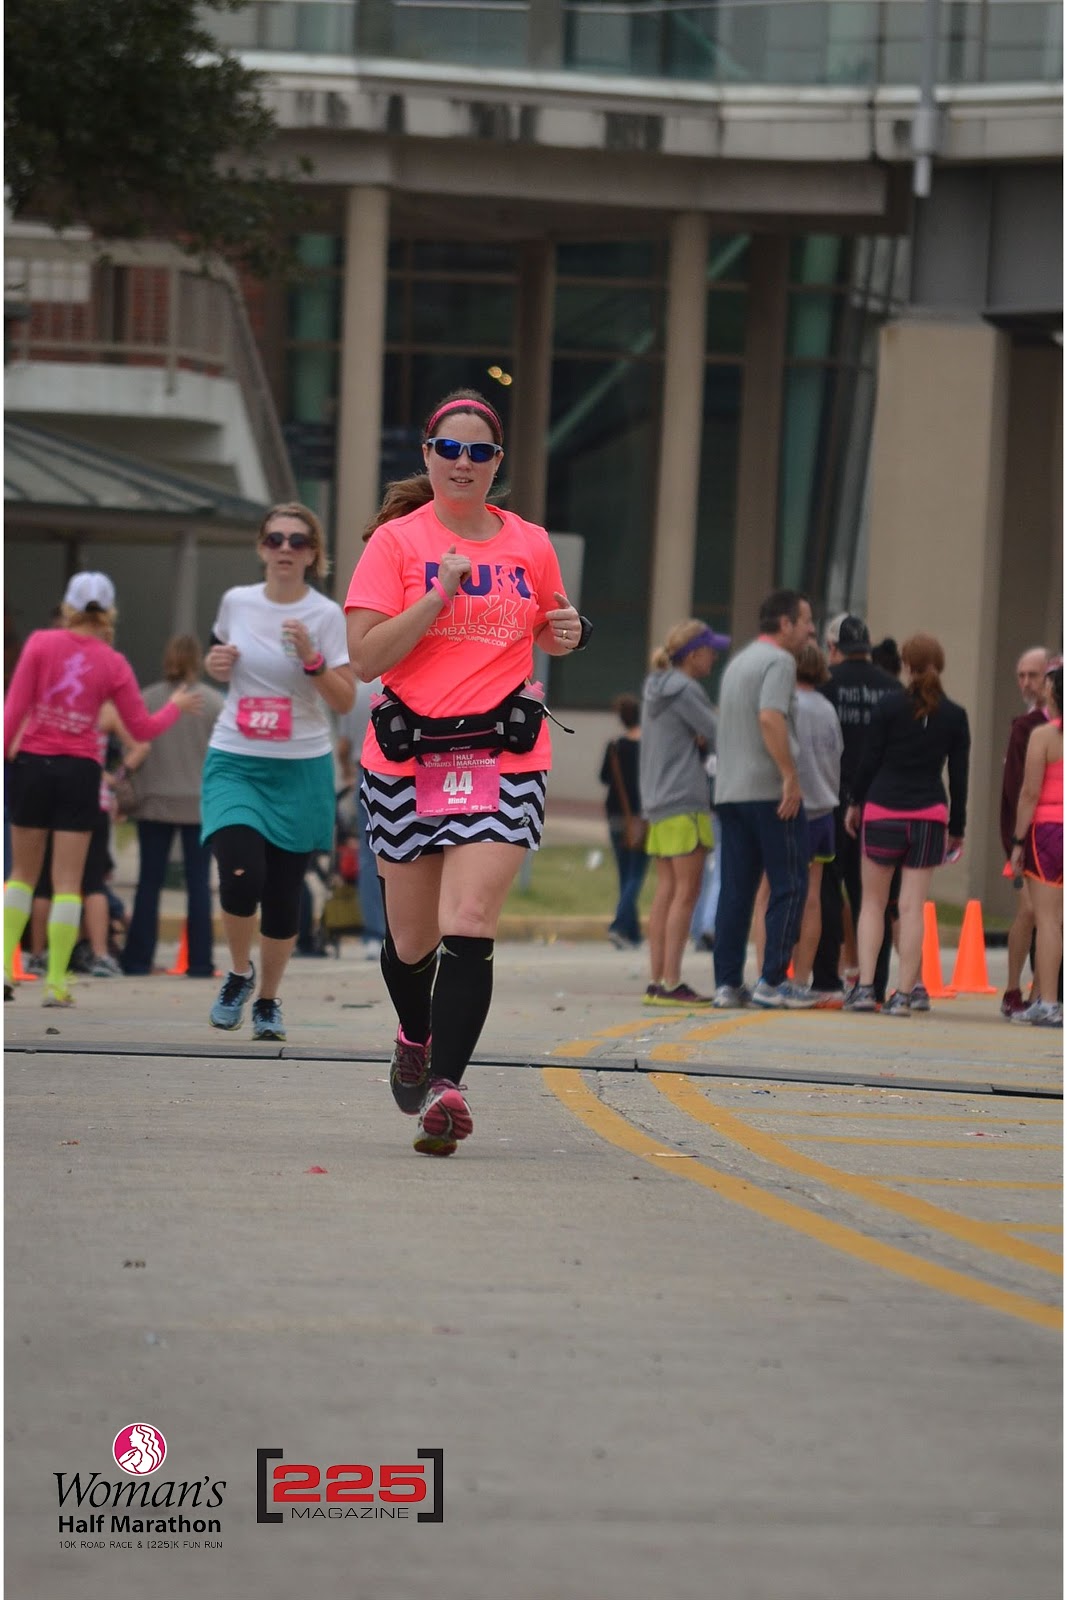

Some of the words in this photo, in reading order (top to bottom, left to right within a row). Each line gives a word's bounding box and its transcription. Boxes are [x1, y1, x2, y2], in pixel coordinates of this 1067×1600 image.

[456, 753, 474, 761] HALF
[456, 758, 496, 767] MARATHON
[443, 771, 473, 796] 44
